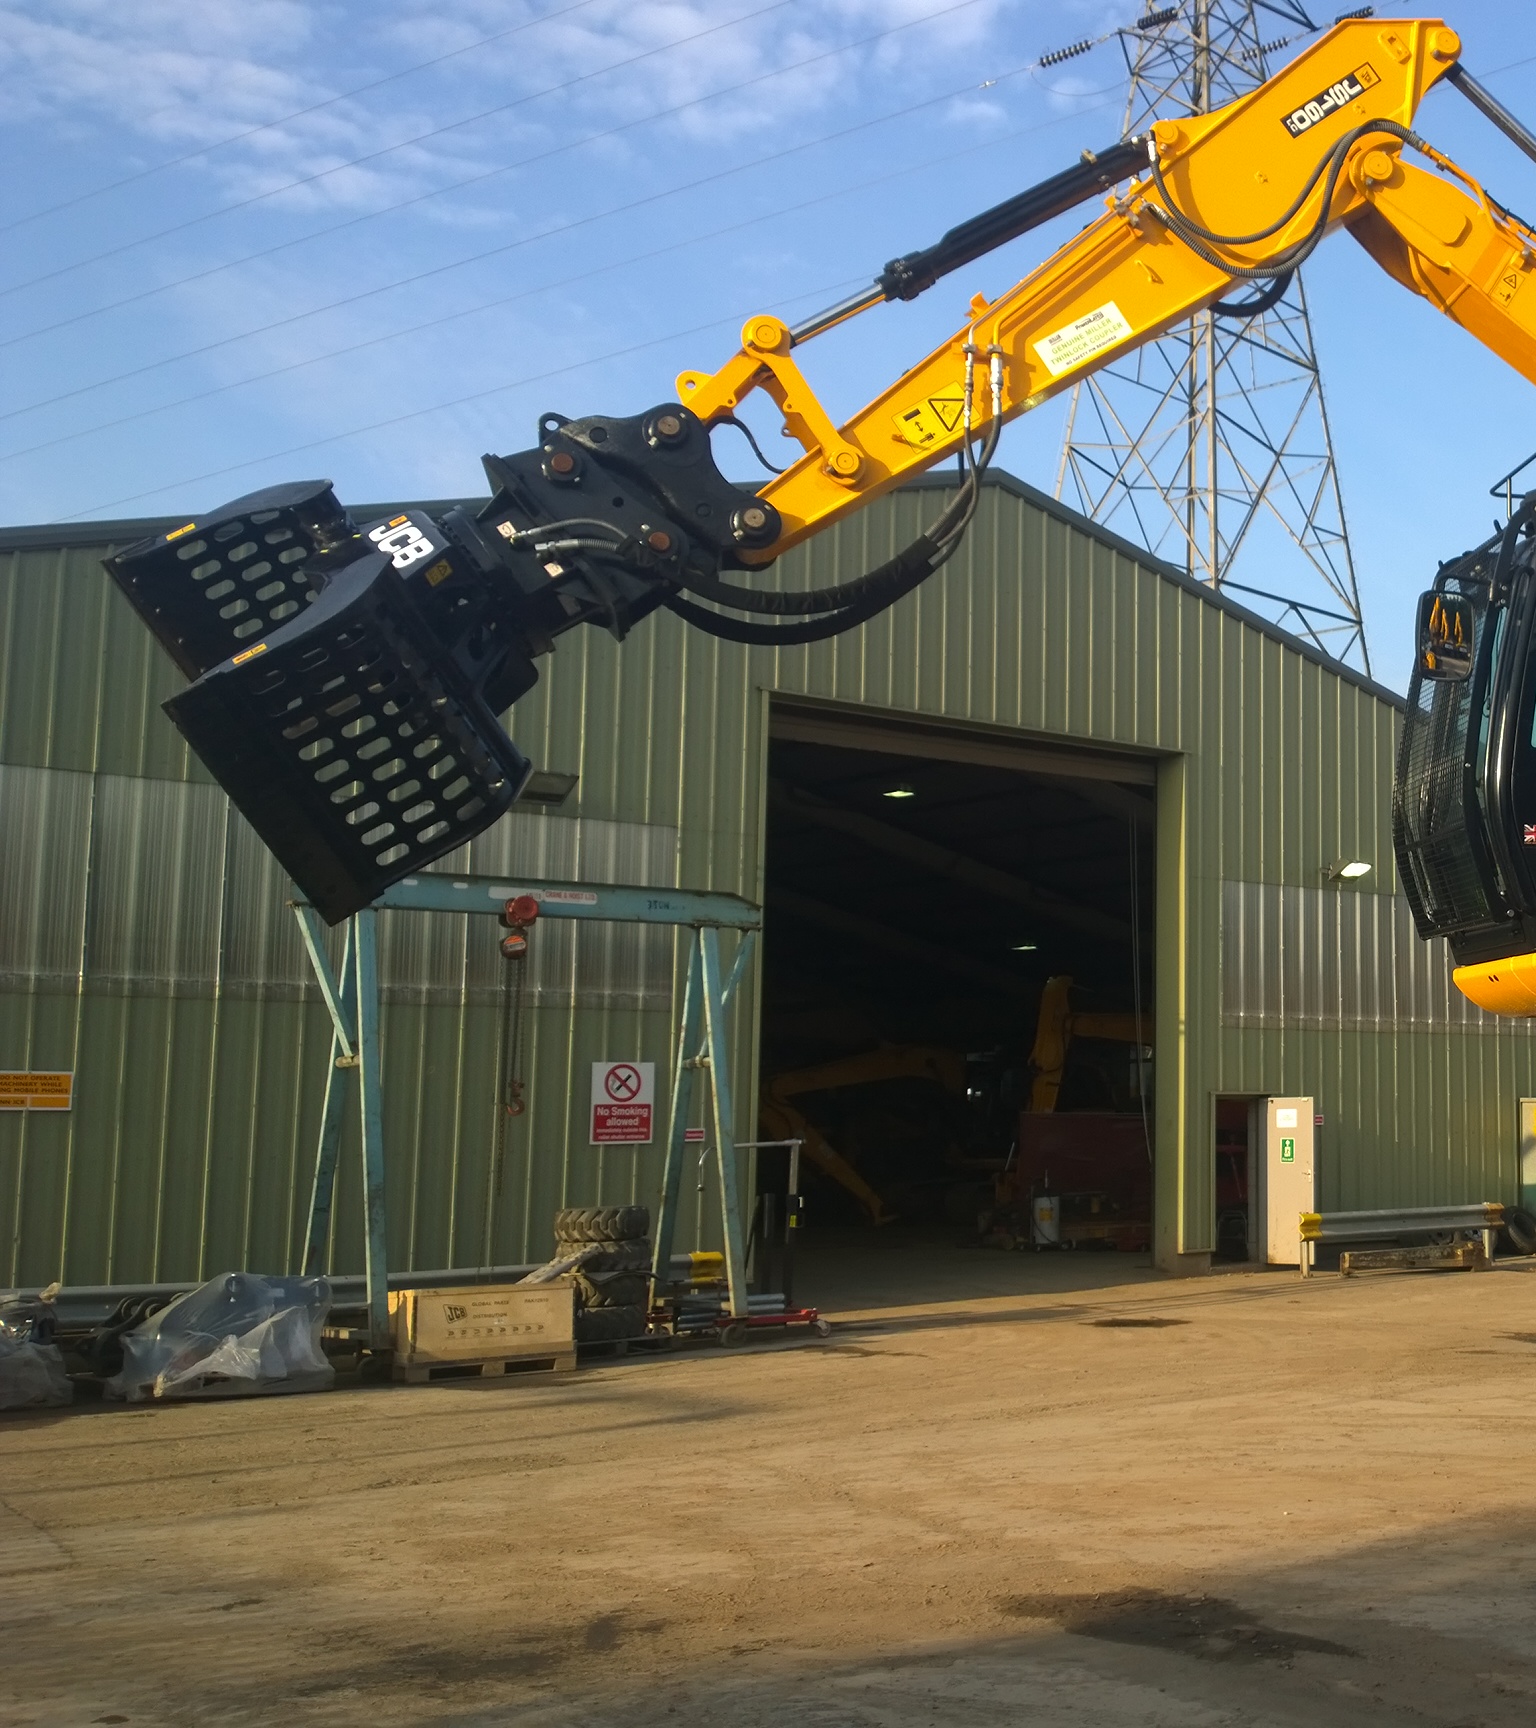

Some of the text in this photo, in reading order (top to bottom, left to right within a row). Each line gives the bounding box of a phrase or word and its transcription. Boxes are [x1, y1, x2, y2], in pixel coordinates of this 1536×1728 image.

[1050, 342, 1089, 365] TWINLOCK
[1089, 322, 1123, 344] COUPLER
[1051, 333, 1085, 355] GENUINE
[1085, 318, 1112, 336] MILLER
[368, 521, 434, 568] JCB
[597, 1107, 648, 1117] No Smoking
[606, 1117, 639, 1126] allowed
[447, 1306, 466, 1321] JCB
